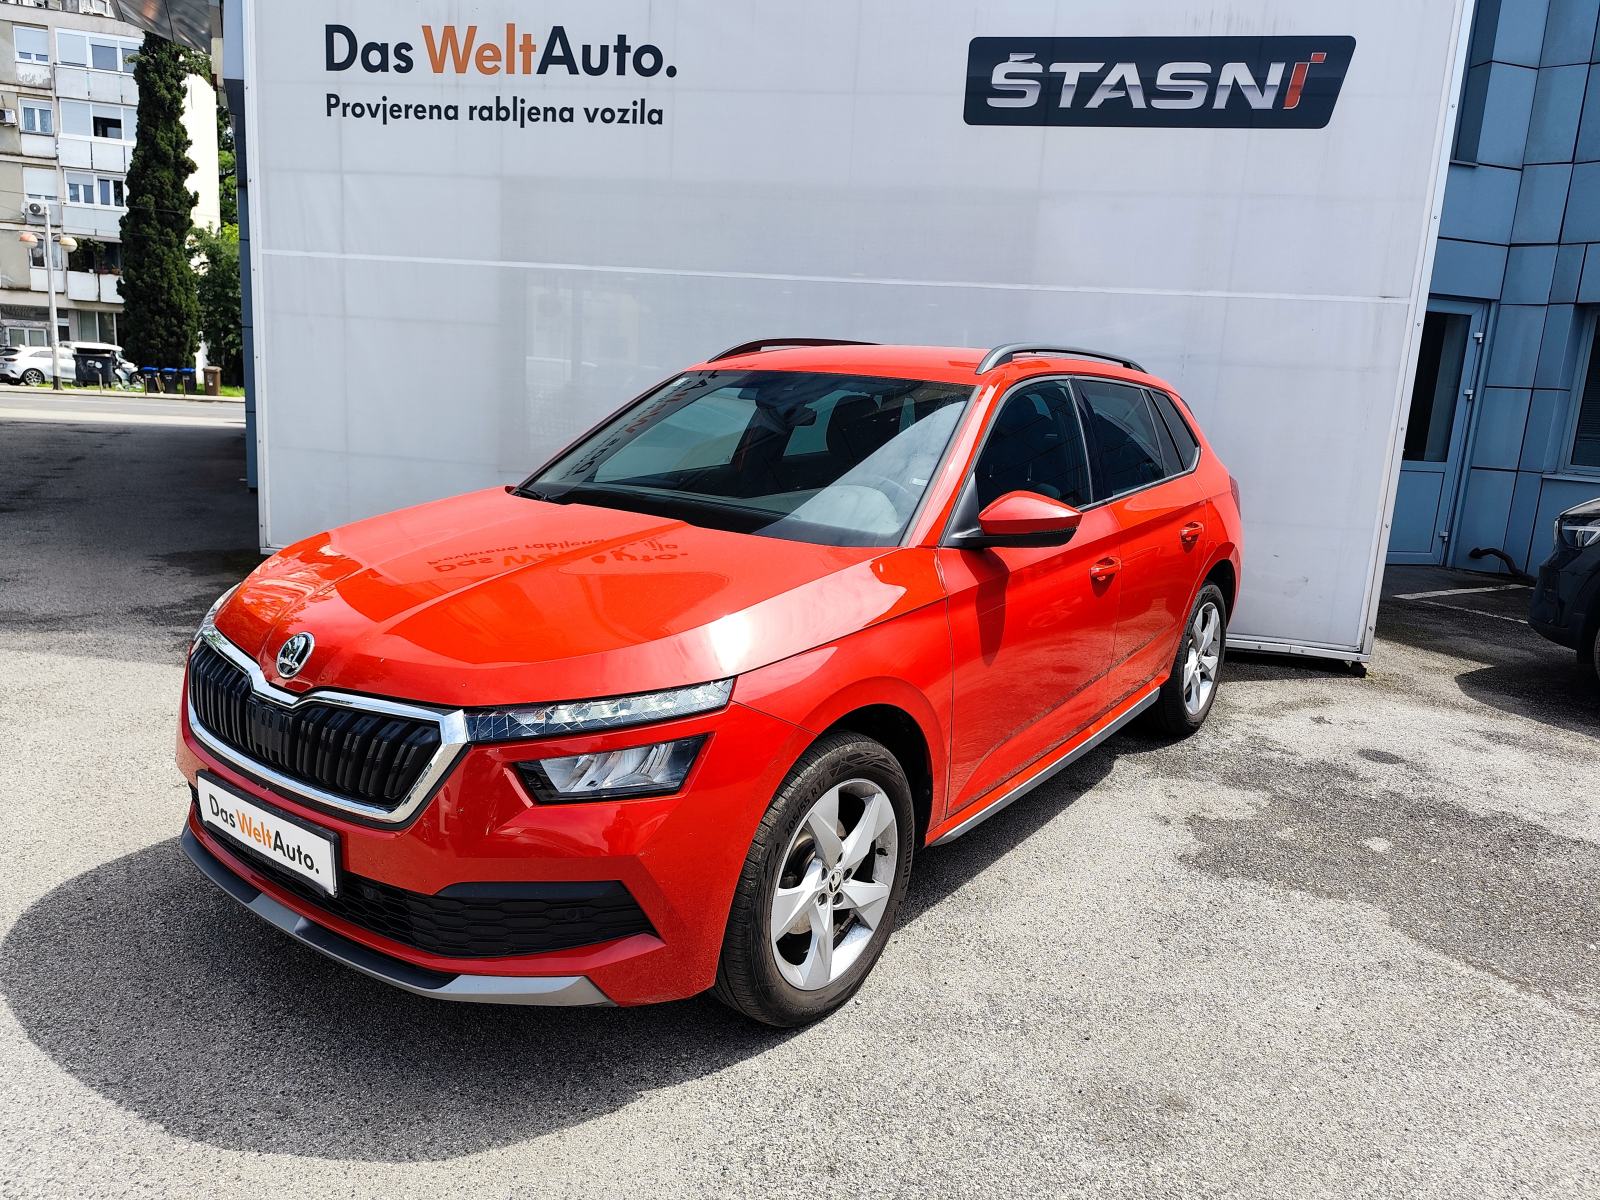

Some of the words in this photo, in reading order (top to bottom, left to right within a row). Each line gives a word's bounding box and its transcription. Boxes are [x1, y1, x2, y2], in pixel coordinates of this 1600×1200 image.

[325, 24, 414, 74] Das
[421, 23, 678, 78] WeltAuto.
[326, 93, 459, 125] Provjerena
[468, 96, 574, 128] rabljena
[584, 98, 664, 125] vozila
